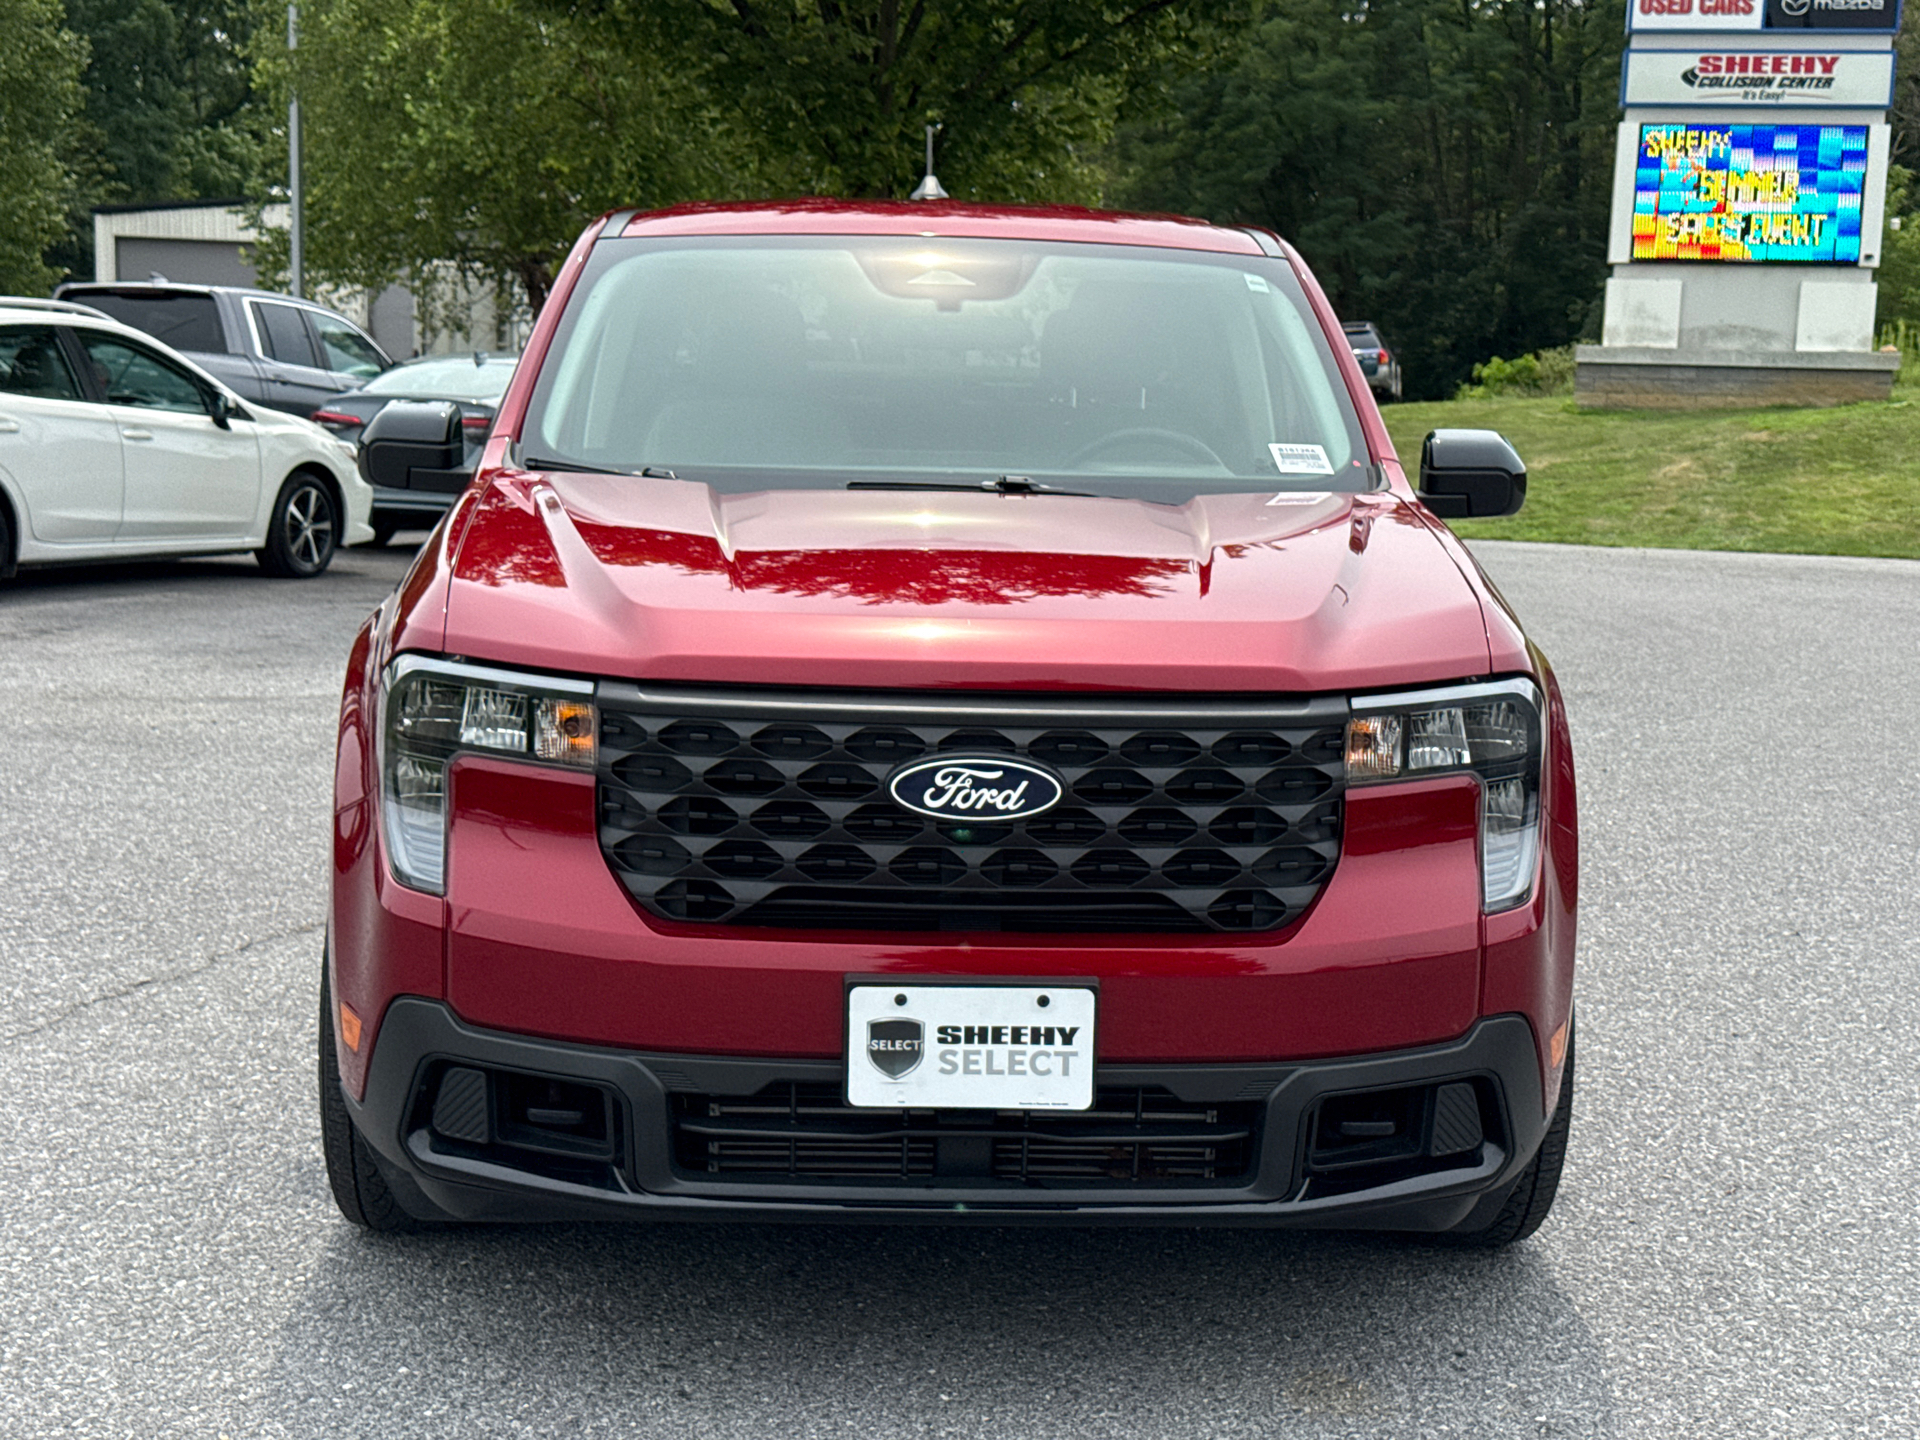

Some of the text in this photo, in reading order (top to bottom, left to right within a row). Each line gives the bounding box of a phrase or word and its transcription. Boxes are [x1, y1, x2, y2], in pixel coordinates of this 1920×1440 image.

[1640, 0, 1754, 15] USED CARS
[1814, 0, 1884, 10] mazda
[1698, 55, 1840, 74] SHEEHY
[1697, 76, 1835, 89] COLLISION CENTER
[1742, 90, 1786, 102] It's Easy!
[1645, 130, 1732, 157] SHEEHY
[1749, 213, 1828, 246] EVENT
[923, 767, 1029, 810] Ford
[870, 1039, 921, 1051] SELECT
[937, 1025, 1080, 1046] SHEEHY
[938, 1049, 1079, 1076] SELECT
